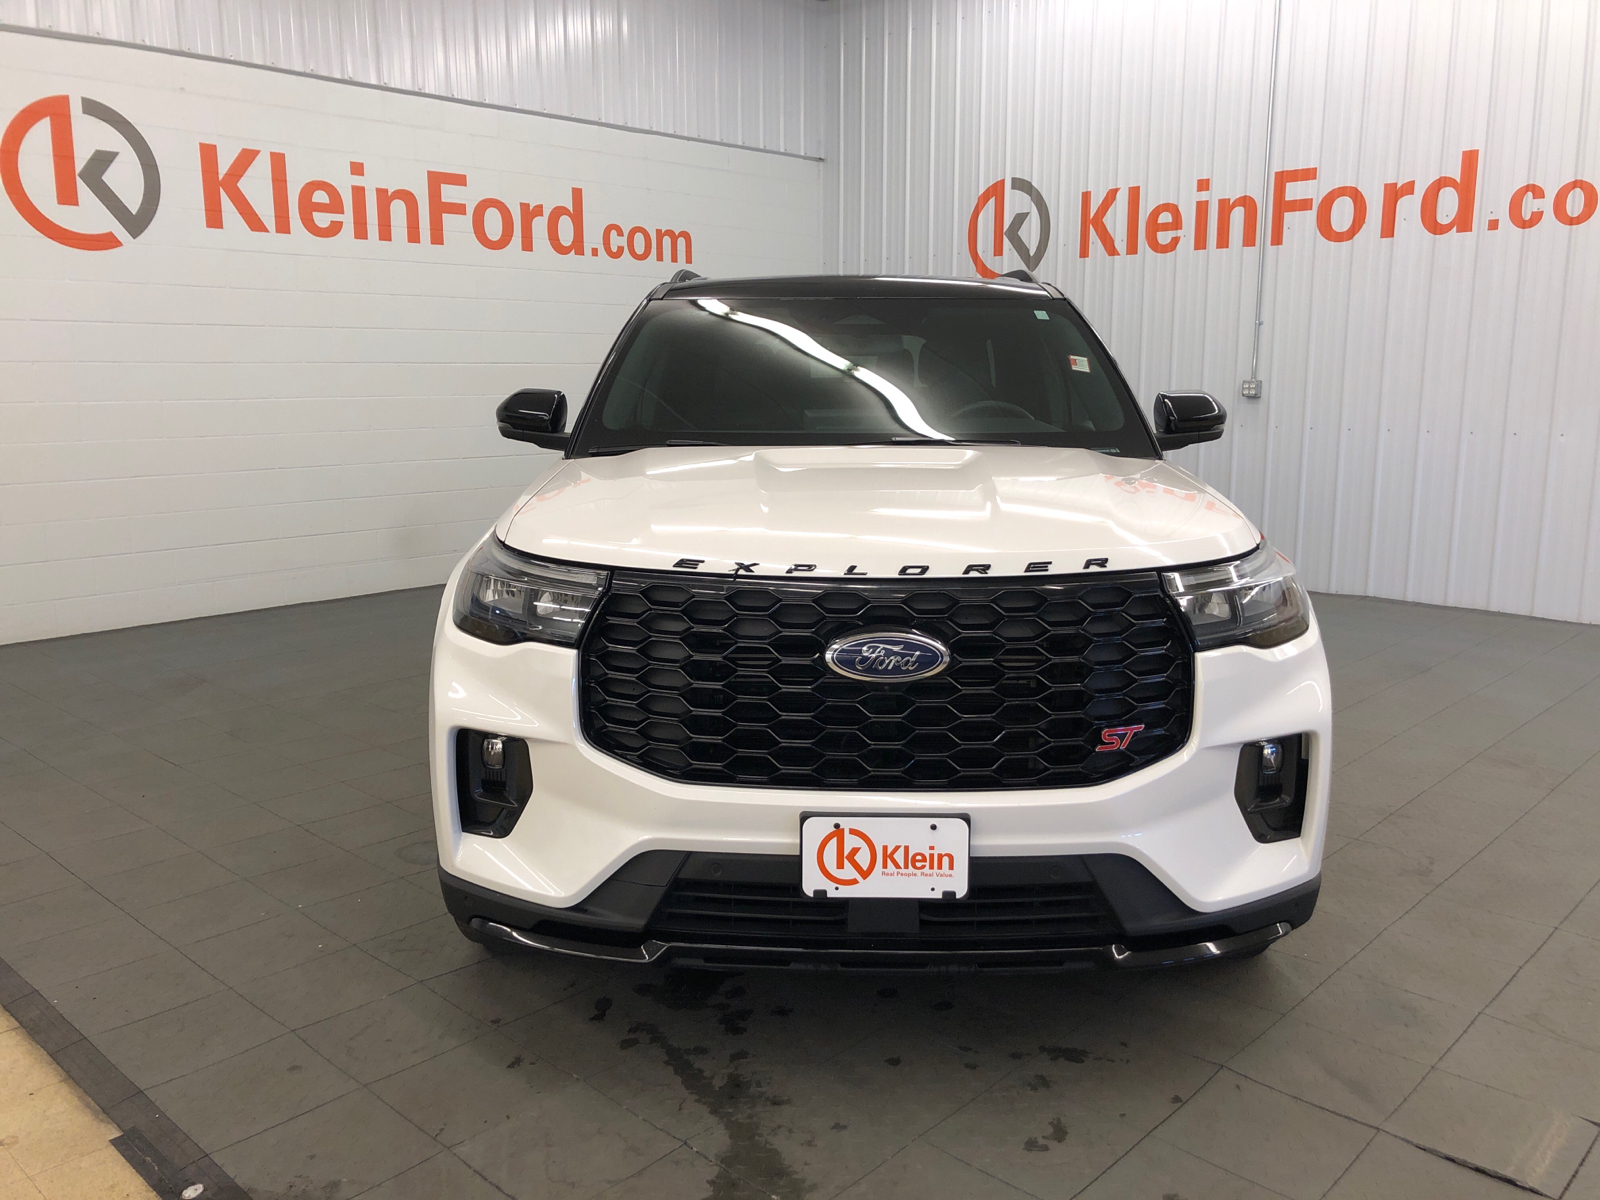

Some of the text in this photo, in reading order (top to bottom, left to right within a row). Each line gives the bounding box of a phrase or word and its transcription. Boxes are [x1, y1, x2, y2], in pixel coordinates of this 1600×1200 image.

[199, 142, 693, 265] KleinFord.com
[672, 556, 1109, 577] EXPLORER
[853, 642, 920, 671] Ford
[1096, 725, 1145, 752] ST
[881, 844, 955, 871] Klein
